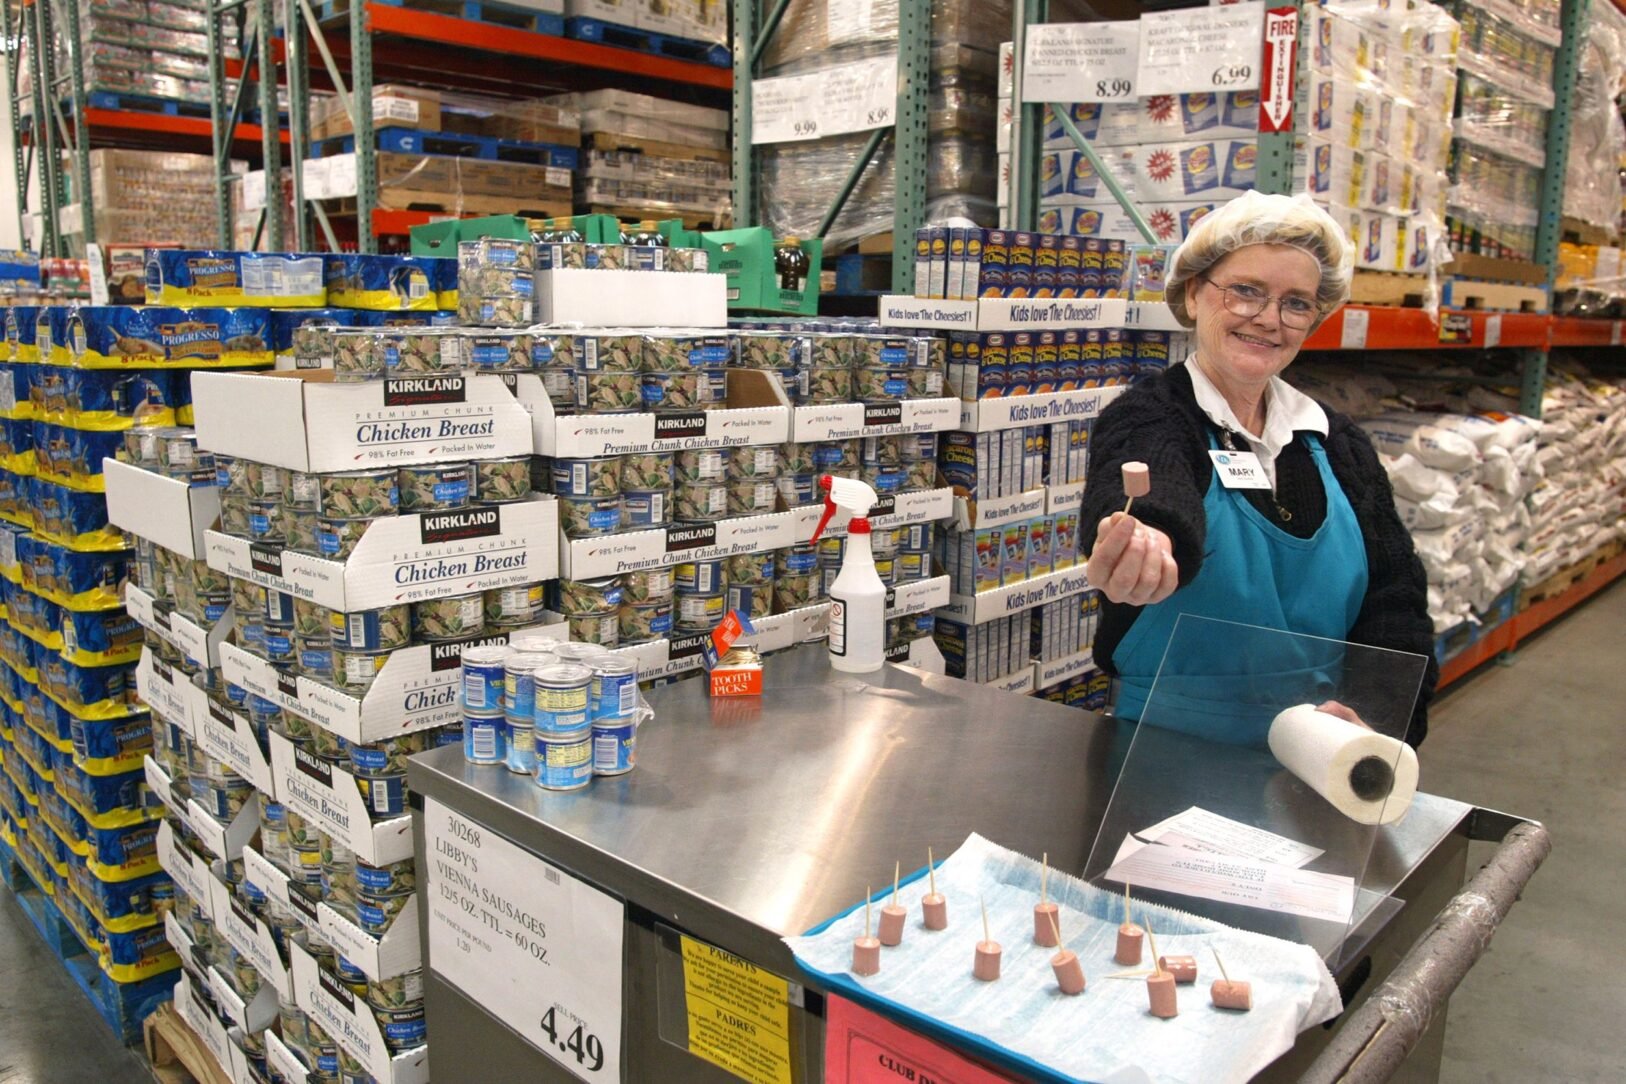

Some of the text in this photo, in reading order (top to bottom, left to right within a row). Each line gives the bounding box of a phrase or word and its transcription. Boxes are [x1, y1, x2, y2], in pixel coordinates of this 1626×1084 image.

[1271, 20, 1295, 36] FIRE
[1212, 65, 1251, 85] 6.99
[1275, 39, 1284, 120] EXTINGUISHER
[1096, 80, 1131, 97] 8.99
[795, 122, 816, 136] 9.99
[189, 266, 235, 275] PROGRESSO
[888, 308, 903, 320] Kids
[905, 310, 919, 320] love
[920, 308, 932, 321] The
[1010, 305, 1028, 322] Kids
[1031, 306, 1048, 321] love
[1049, 304, 1063, 320] The
[162, 329, 220, 347] PROGRESSO
[121, 354, 156, 363] 8 Pack
[388, 378, 463, 393] KIRKLAND
[355, 406, 494, 420] PREMIUM CHUNK
[866, 407, 900, 418] KIRKLAND
[1010, 406, 1029, 421] Kids
[1030, 402, 1047, 418] love
[1048, 399, 1062, 417] The
[357, 418, 494, 444] Chicken Breast
[584, 427, 598, 435] 98%
[657, 418, 705, 430] KIRKLAND
[827, 422, 933, 438] Premium Chunk Chicken Breast
[442, 442, 495, 453] Packed In Water
[603, 434, 750, 454] Premium Chunk Chicken Breast
[368, 450, 384, 459] 98%
[1228, 468, 1254, 476] MARY
[435, 487, 457, 495] Chicken
[1054, 494, 1075, 504] Kids love
[879, 511, 926, 526] Chicken Breast
[984, 509, 997, 519] Kids
[998, 506, 1009, 517] love
[425, 512, 497, 531] KIRKLAND
[668, 528, 715, 543] KIRKLAND
[393, 538, 527, 561] PREMIUM CHUNK
[616, 541, 758, 572] Premium Chunk Chicken Breast
[252, 551, 281, 567] KIRKLAND
[394, 551, 527, 584] Chicken Breast
[228, 563, 314, 598] Premium Chunk Chicken Breast
[477, 579, 500, 588] Packed
[509, 574, 528, 583] Water
[407, 587, 452, 599] 98% Fat Free
[1006, 593, 1025, 611] Kids
[1026, 589, 1043, 606] love
[1044, 582, 1058, 599] The
[905, 602, 926, 613] Breast
[665, 657, 694, 671] Chunk
[712, 672, 751, 686] TOOTH
[714, 682, 747, 696] PICKS
[243, 676, 330, 725] Premium Chicken Breast
[415, 710, 459, 726] 98% Fat Free
[296, 748, 330, 775] KIRKLAND
[287, 778, 349, 828] Chicken Breast
[448, 816, 481, 848] 30268
[435, 837, 478, 873] LIBBY'S
[436, 860, 546, 938] VIENNA SAUSAGES
[481, 909, 502, 935] TTL
[514, 932, 528, 950] 60
[530, 943, 551, 966] OZ.
[710, 947, 757, 974] PARENTS
[310, 992, 370, 1056] Chicken Breast
[553, 1002, 588, 1030] SELL PRICE
[716, 1010, 756, 1036] PADRES
[540, 1006, 604, 1072] 4.49
[879, 1054, 915, 1081] CLUB
